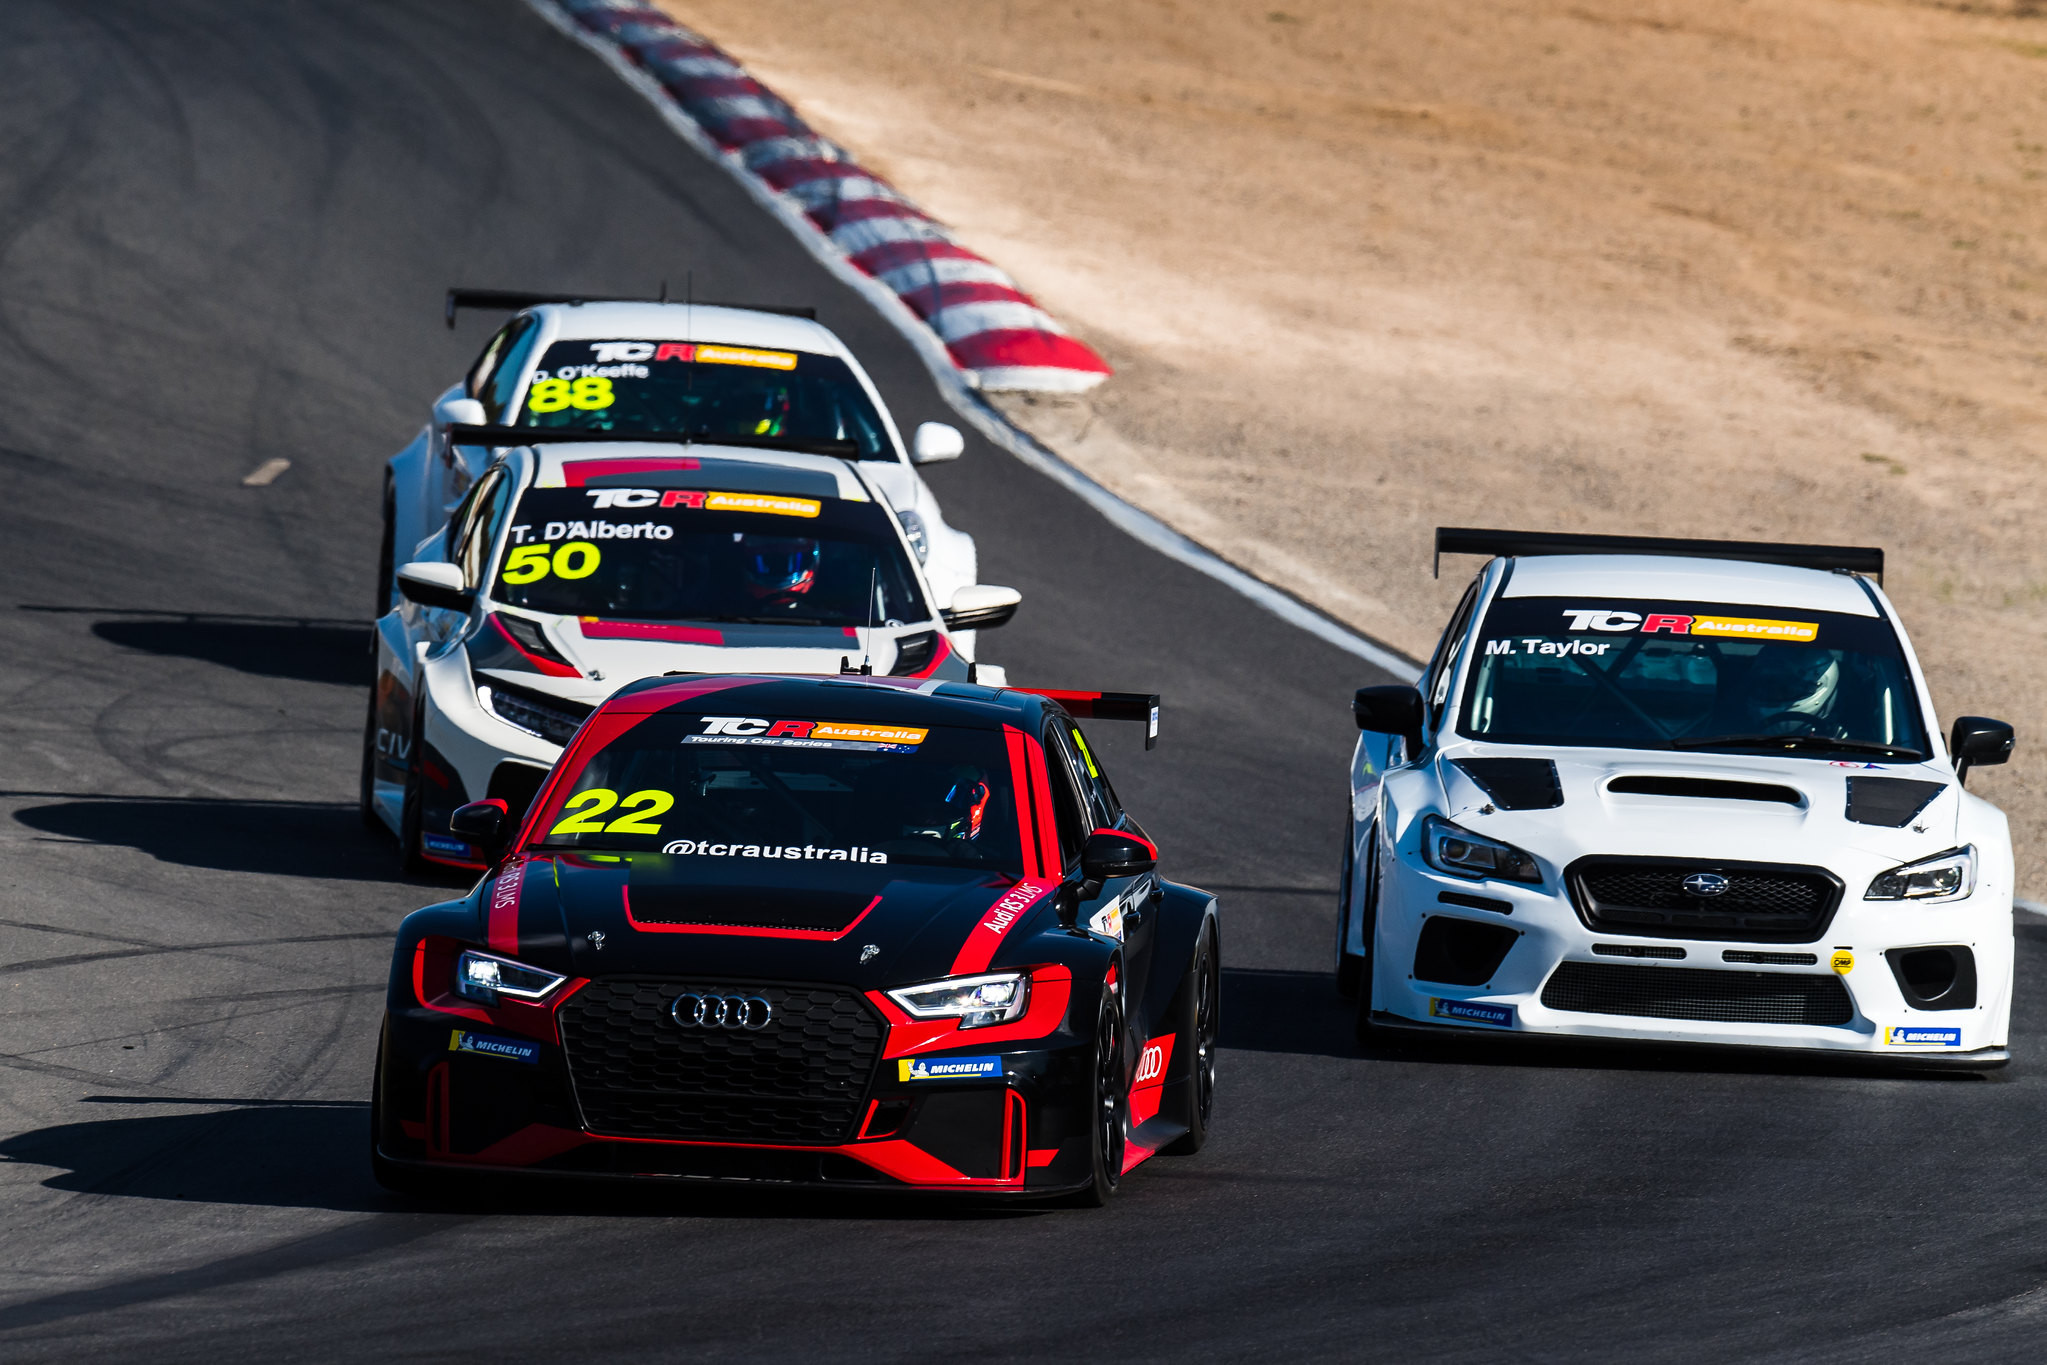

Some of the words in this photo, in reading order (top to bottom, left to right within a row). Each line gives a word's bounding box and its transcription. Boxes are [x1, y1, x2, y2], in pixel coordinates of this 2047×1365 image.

[590, 341, 696, 362] TCR
[528, 376, 615, 413] 88
[586, 488, 705, 509] TCR
[711, 495, 816, 513] Australia
[511, 525, 535, 543] T.
[544, 520, 674, 541] D'Alberto
[502, 541, 601, 584] 50
[1562, 609, 1694, 634] TCR
[1697, 620, 1813, 637] Australia
[1485, 639, 1516, 655] M.
[1522, 638, 1610, 658] Taylor
[700, 716, 815, 738] TCR
[817, 726, 922, 740] Australia
[691, 736, 746, 744] Touring
[780, 740, 833, 748] Series
[549, 788, 675, 835] 22
[662, 839, 888, 864] @tcraustralia
[1009, 893, 1031, 904] 3
[1014, 882, 1043, 899] LMS
[998, 898, 1025, 913] RS
[983, 908, 1016, 935] Audi
[1451, 1006, 1507, 1021] MICHELIN
[1905, 1032, 1957, 1042] MICHELIN
[475, 1040, 533, 1057] MICHELIN
[930, 1062, 994, 1074] MICHELIN
